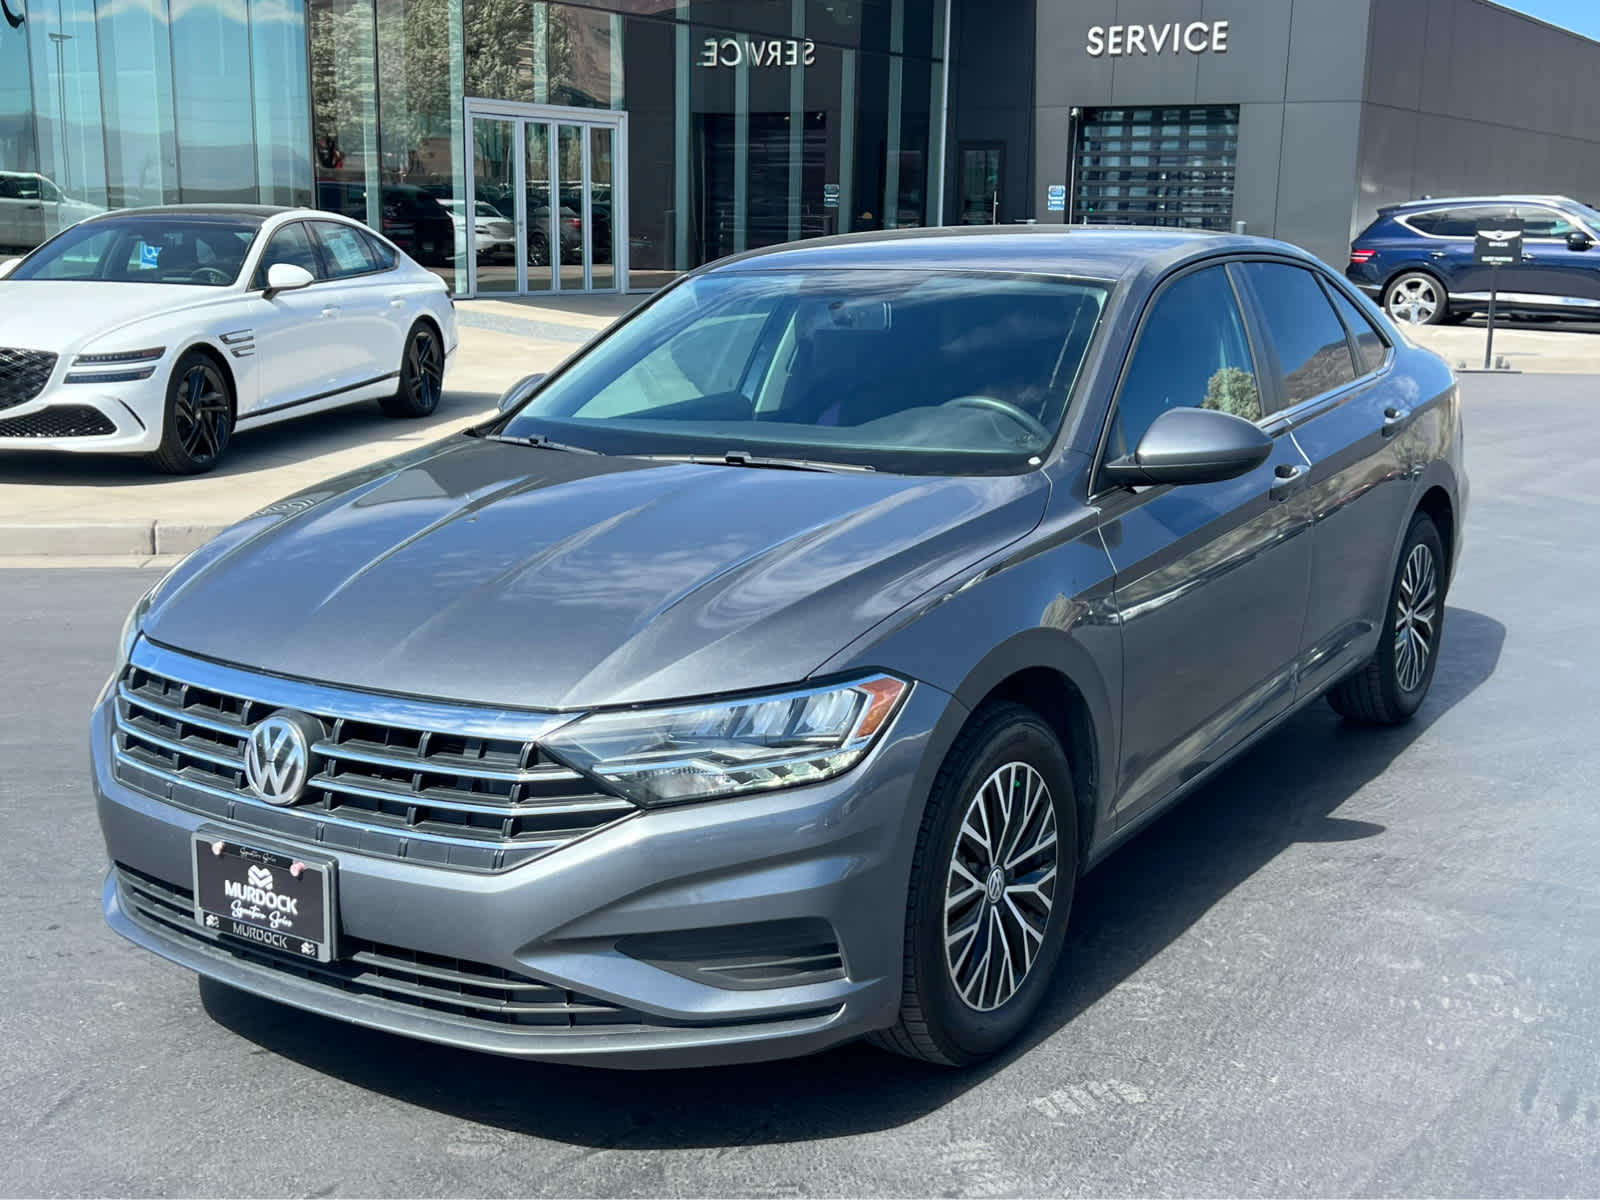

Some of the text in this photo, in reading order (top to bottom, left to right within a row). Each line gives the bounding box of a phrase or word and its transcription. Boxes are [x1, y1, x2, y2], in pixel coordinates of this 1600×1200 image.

[1086, 21, 1229, 56] SERVICE
[248, 718, 305, 802] VW
[224, 879, 298, 915] MURDOCK
[232, 922, 288, 949] MURDOCK
